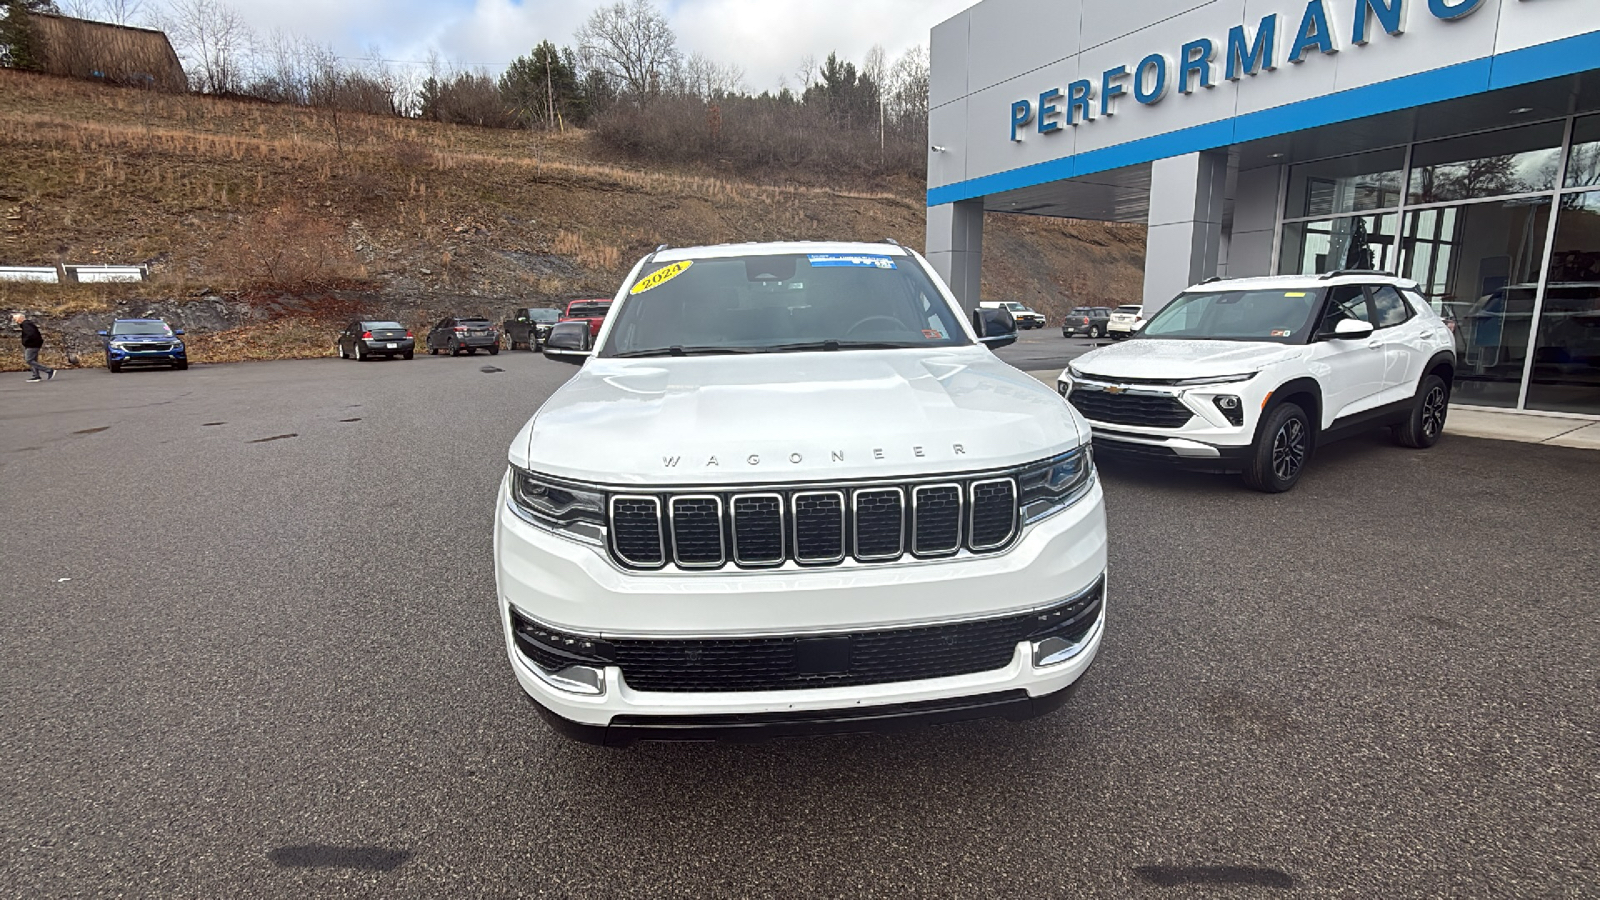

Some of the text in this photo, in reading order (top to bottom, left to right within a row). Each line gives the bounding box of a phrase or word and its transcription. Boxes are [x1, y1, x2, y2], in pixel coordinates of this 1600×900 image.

[1010, 0, 1488, 142] PERFORMAN
[642, 264, 682, 289] 2024
[662, 444, 966, 467] WAGONEER
